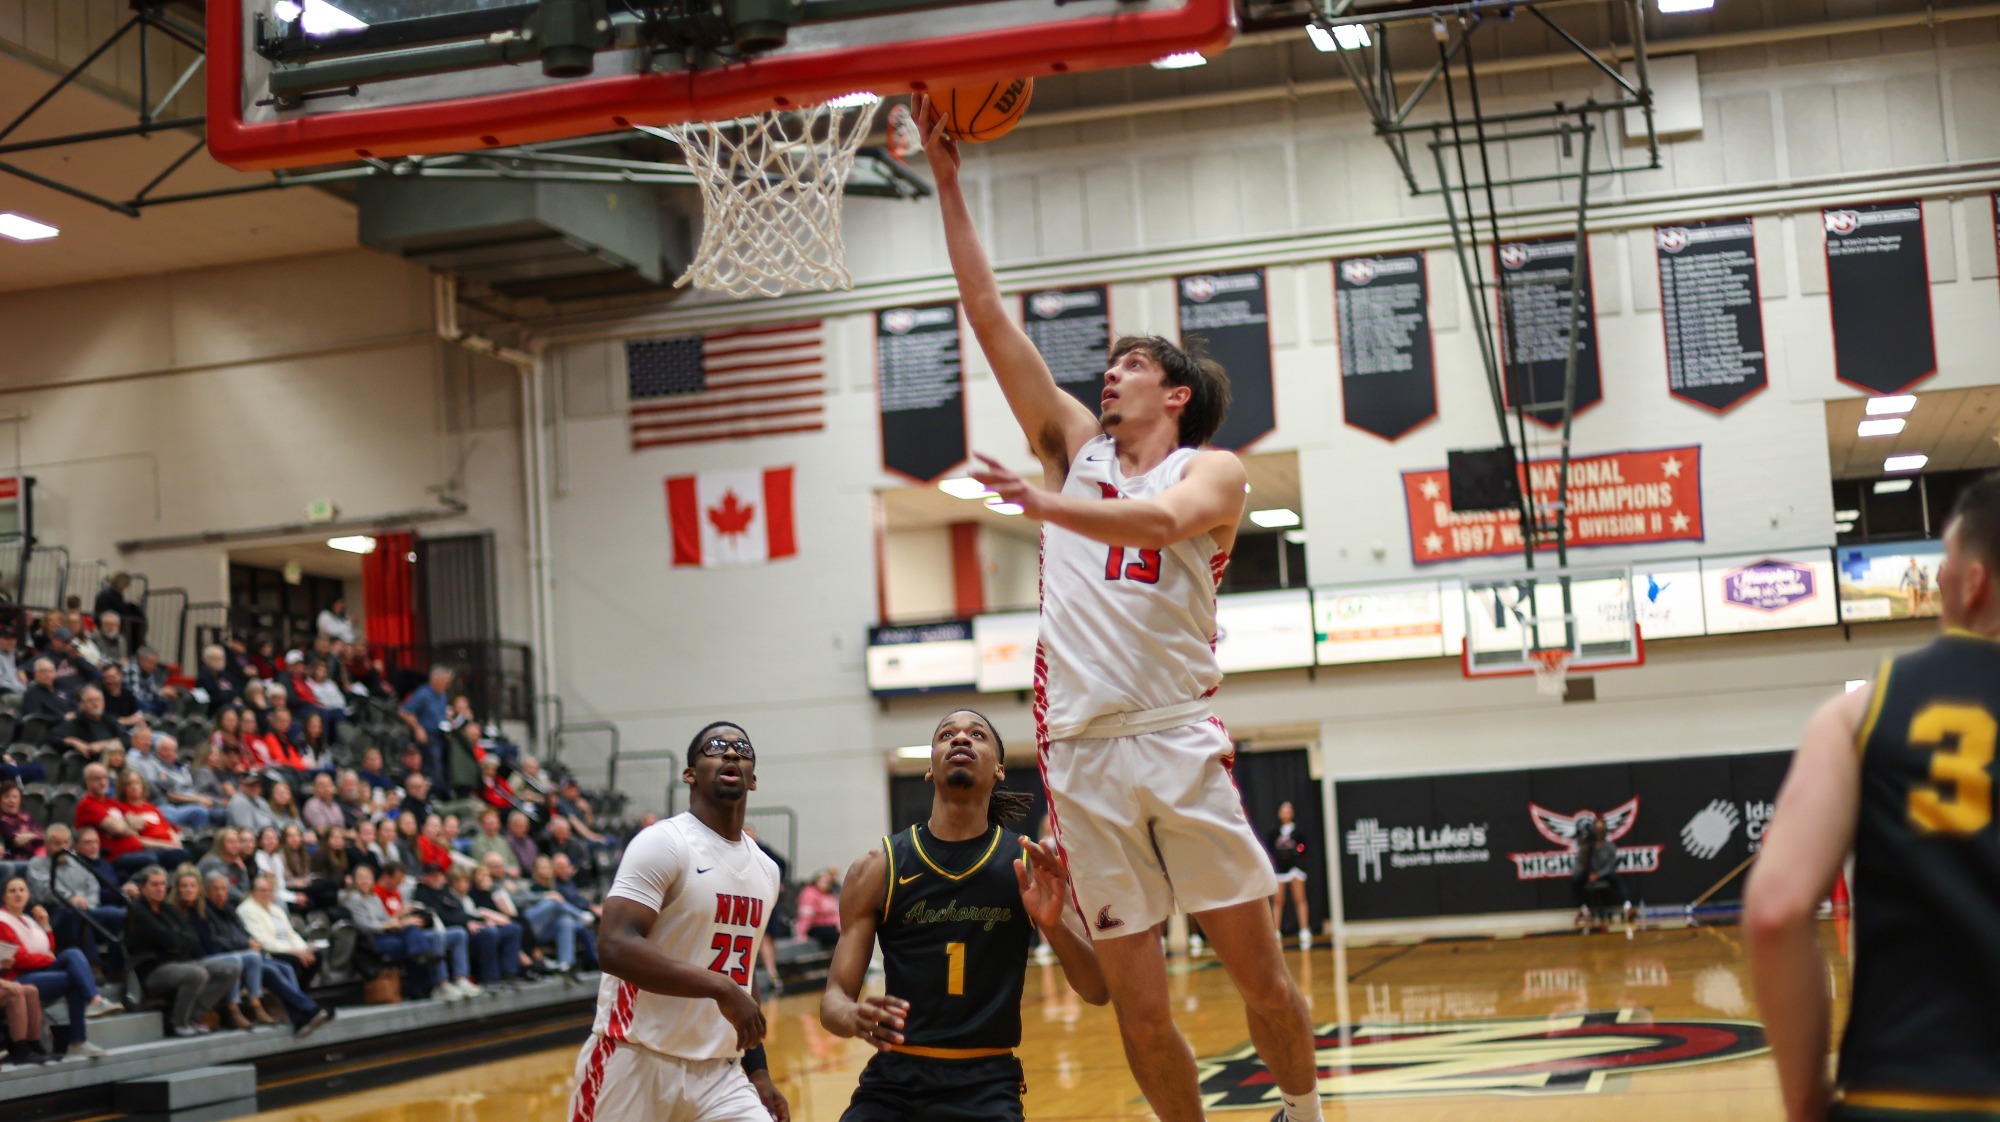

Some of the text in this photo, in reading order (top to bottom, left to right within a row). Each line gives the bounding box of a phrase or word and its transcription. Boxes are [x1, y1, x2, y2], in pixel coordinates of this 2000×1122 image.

[1530, 459, 1624, 491] NAIONAL
[1565, 481, 1673, 515] CHAMPIONS
[1451, 524, 1495, 553] 1997
[1578, 513, 1645, 538] DIVISION
[1908, 701, 1997, 836] 3
[1391, 823, 1487, 851] St Luke's
[1391, 849, 1490, 868] Sports Medicine
[1521, 850, 1655, 873] NIGHWKS
[715, 893, 763, 928] NNU
[902, 899, 1012, 931] Anchorage
[708, 932, 753, 986] 23
[946, 942, 965, 995] 1
